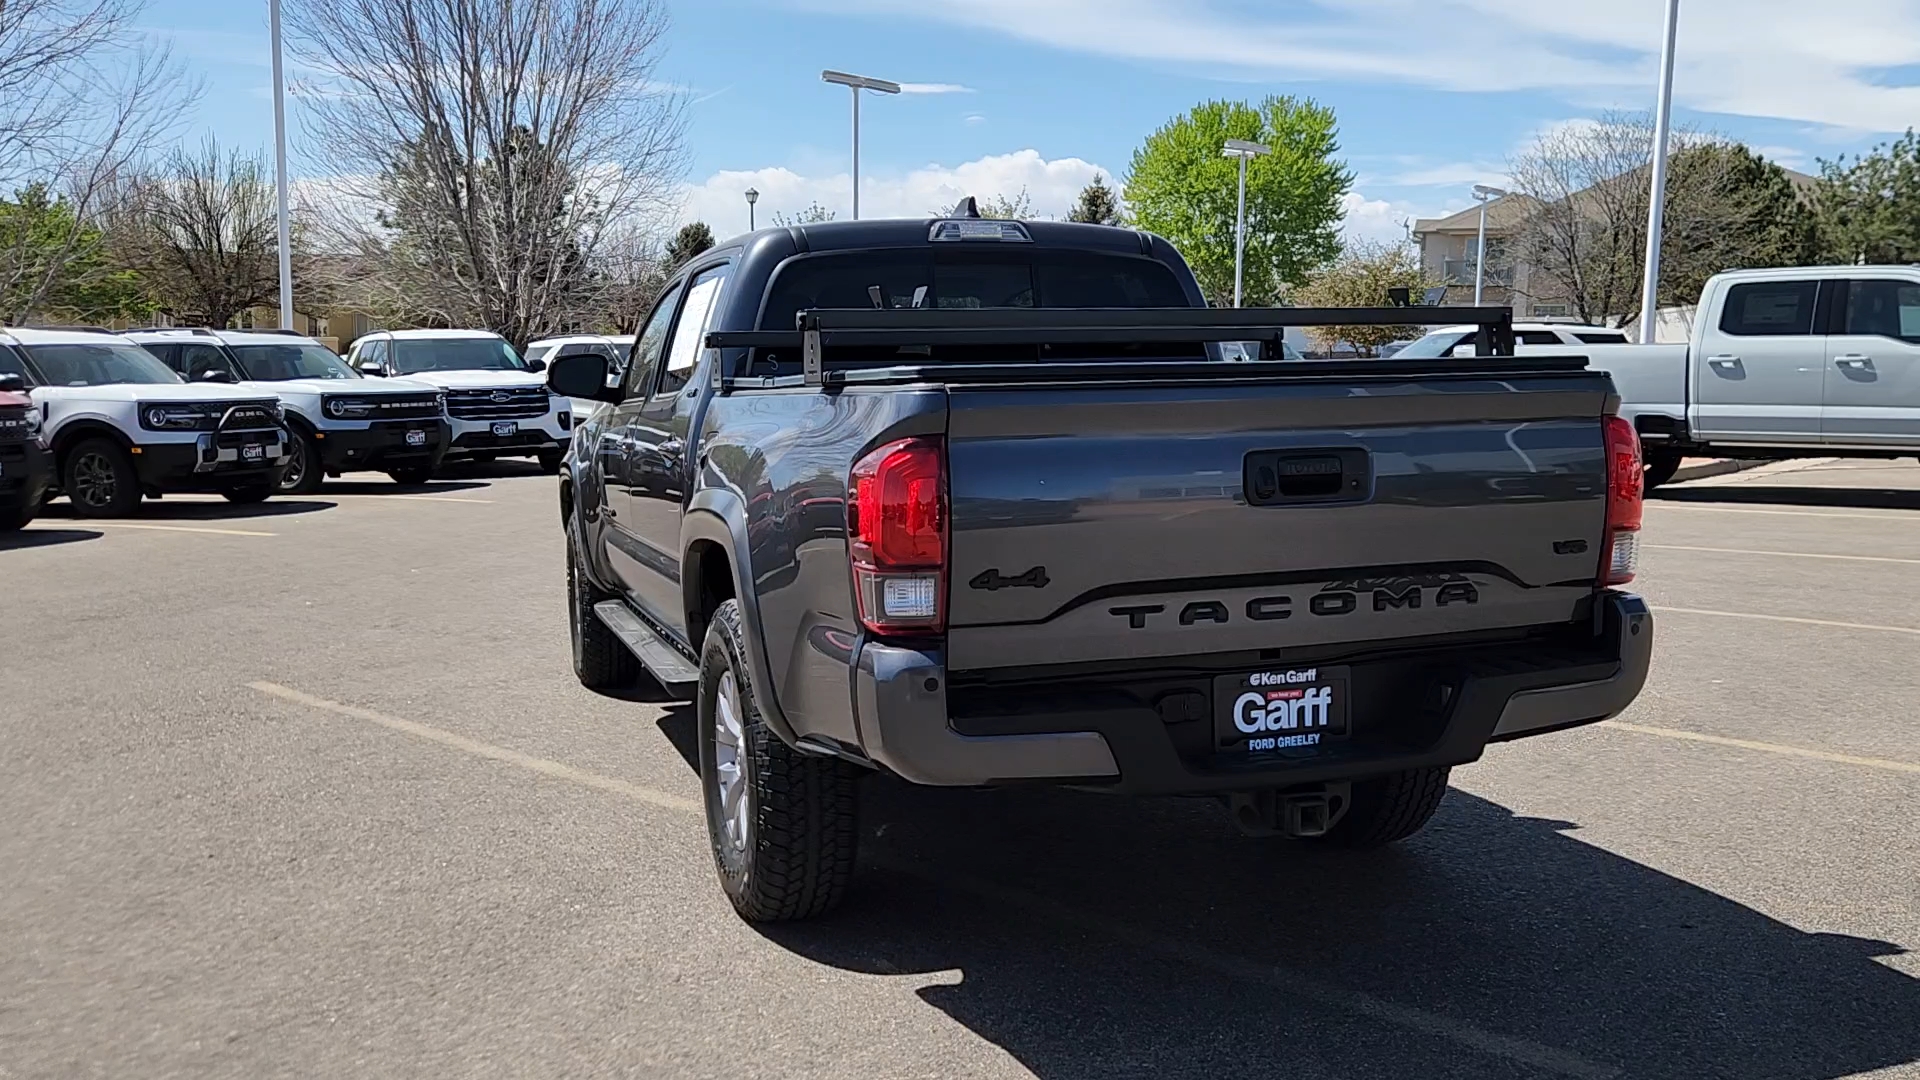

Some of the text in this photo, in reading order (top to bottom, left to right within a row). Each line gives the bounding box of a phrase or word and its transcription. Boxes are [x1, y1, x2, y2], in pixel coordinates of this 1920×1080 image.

[1107, 581, 1480, 629] TACOMA
[1261, 668, 1317, 685] Ken Garff
[1233, 686, 1332, 734] Garff
[1249, 733, 1321, 750] FORD GREELEY
